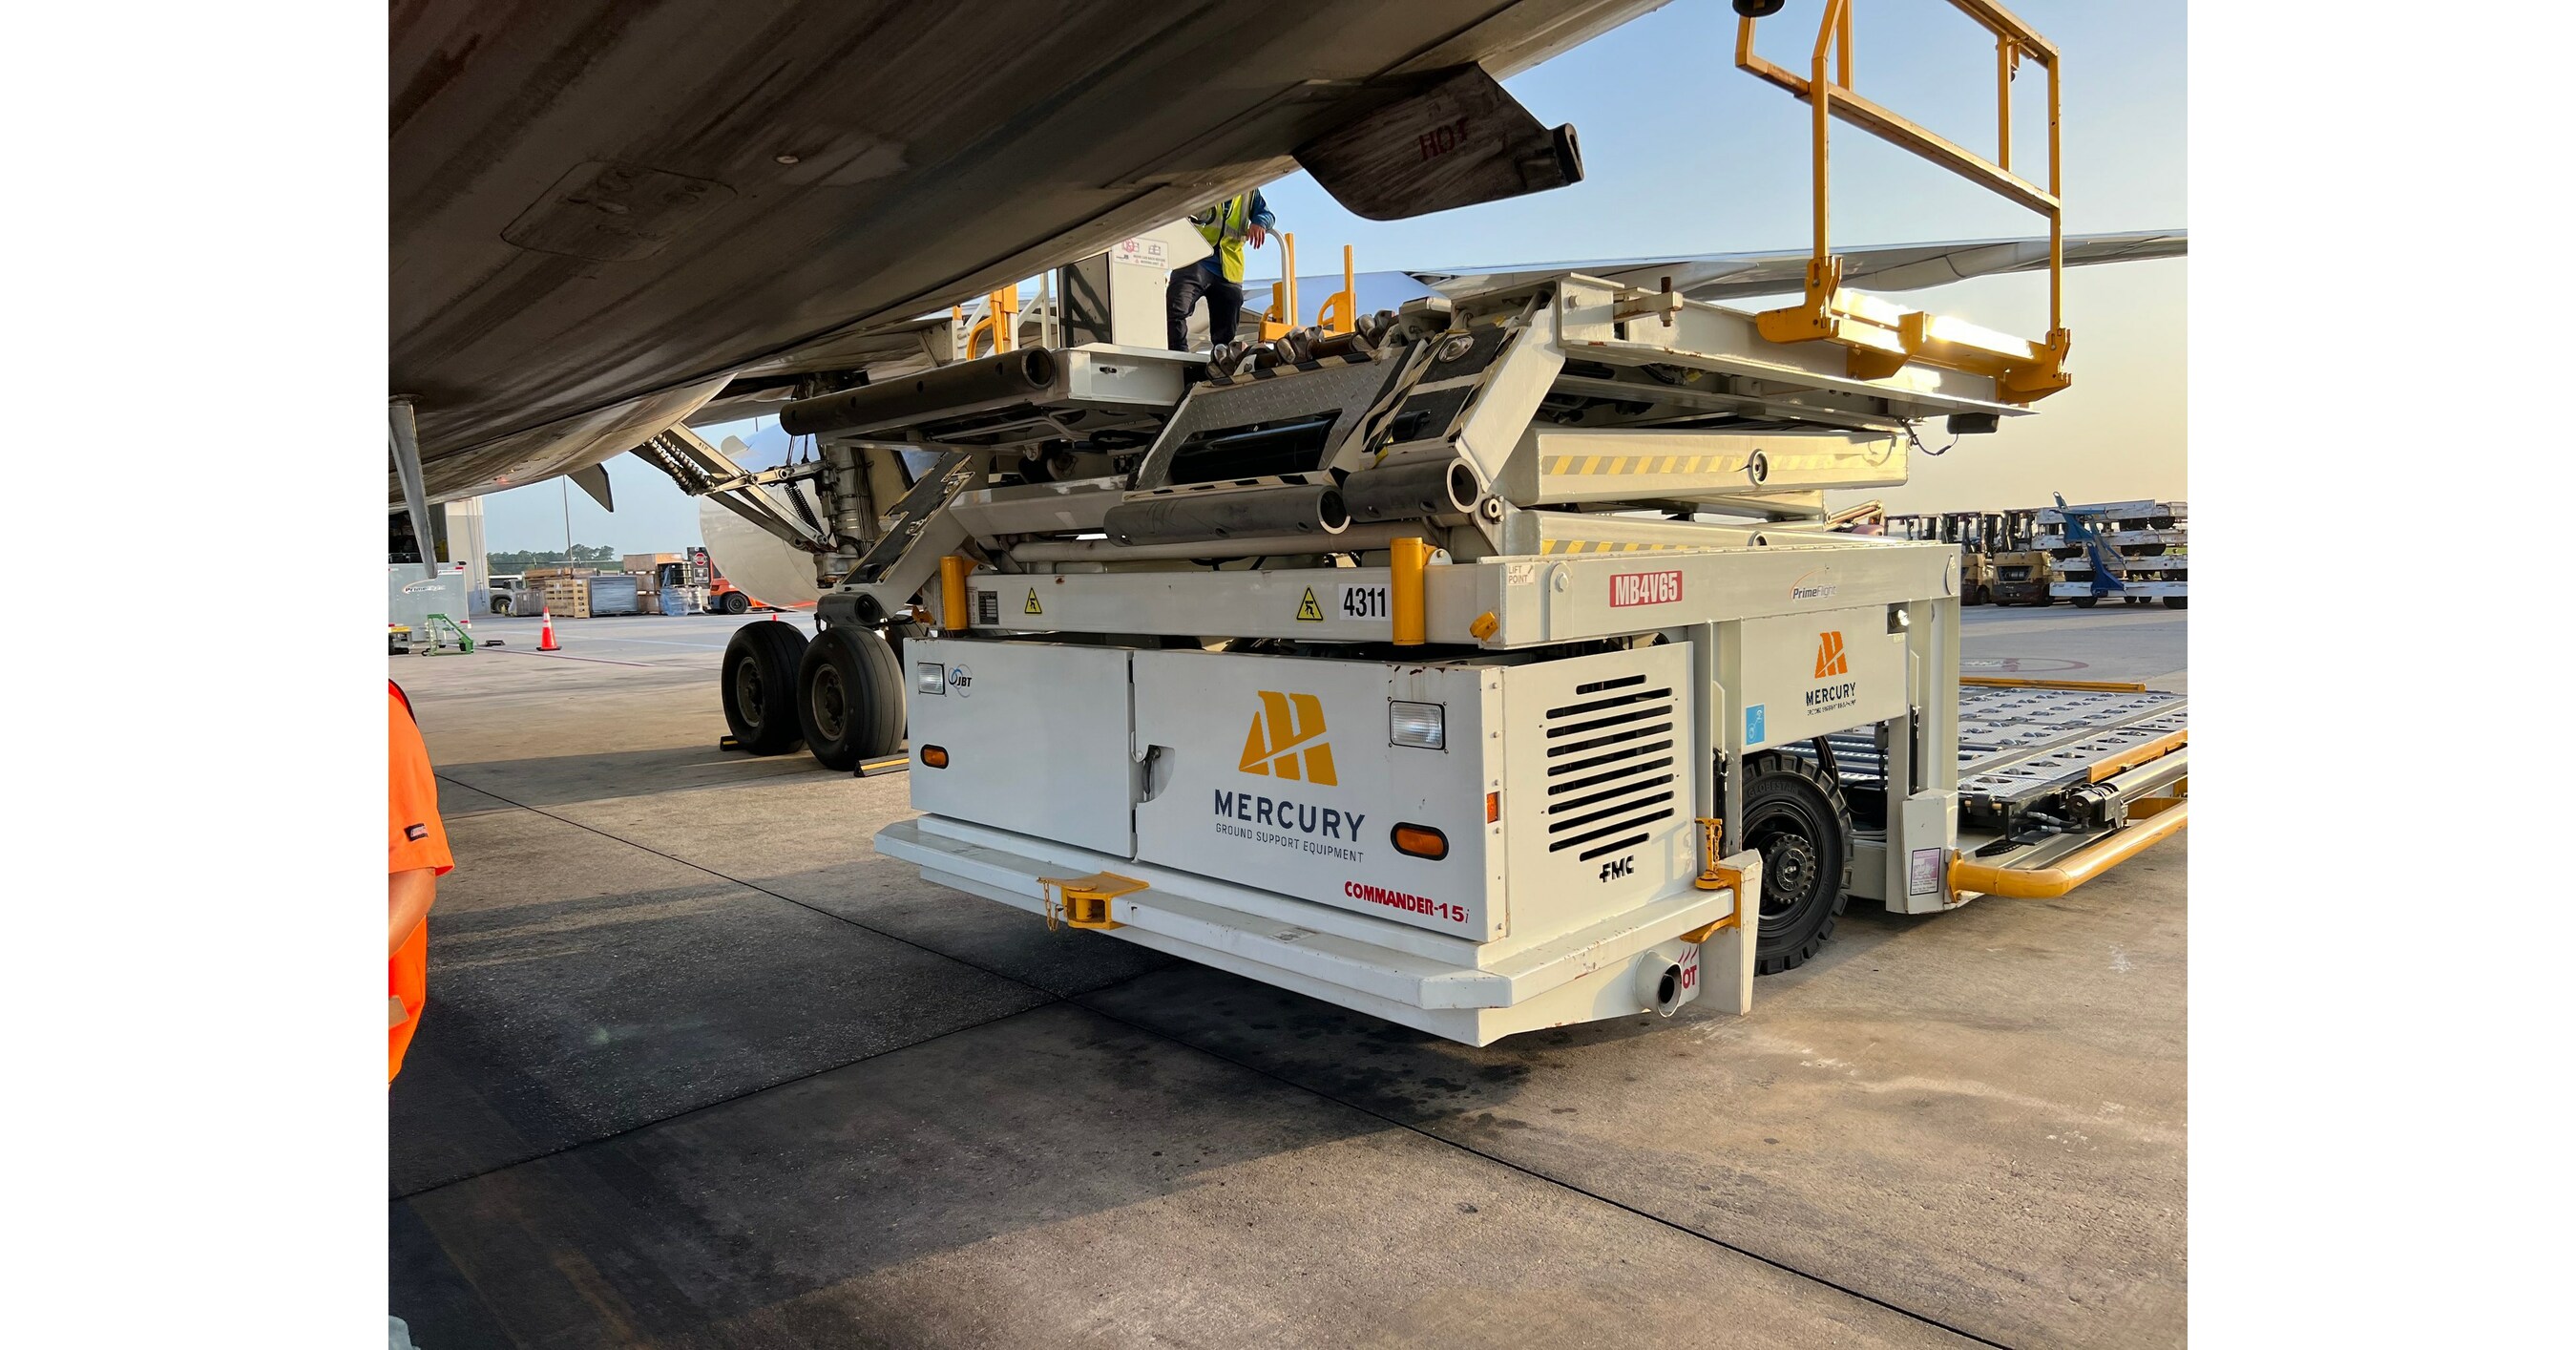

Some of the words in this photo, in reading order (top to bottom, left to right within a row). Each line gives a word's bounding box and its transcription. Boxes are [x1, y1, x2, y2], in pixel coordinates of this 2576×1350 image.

[1419, 117, 1470, 161] HOT
[1508, 565, 1522, 575] LIFT
[1508, 574, 1528, 583] POINT
[1343, 587, 1386, 618] 4311
[1615, 572, 1678, 606] MB4V65
[956, 676, 973, 687] JBT
[1806, 682, 1856, 707] MERCURY
[1214, 789, 1366, 842] MERCURY
[1215, 822, 1253, 839] GROUND
[1256, 831, 1300, 850] SUPPORT
[1303, 840, 1364, 863] EQUIPMENT
[1599, 854, 1635, 883] FMC
[1682, 964, 1698, 990] OT
